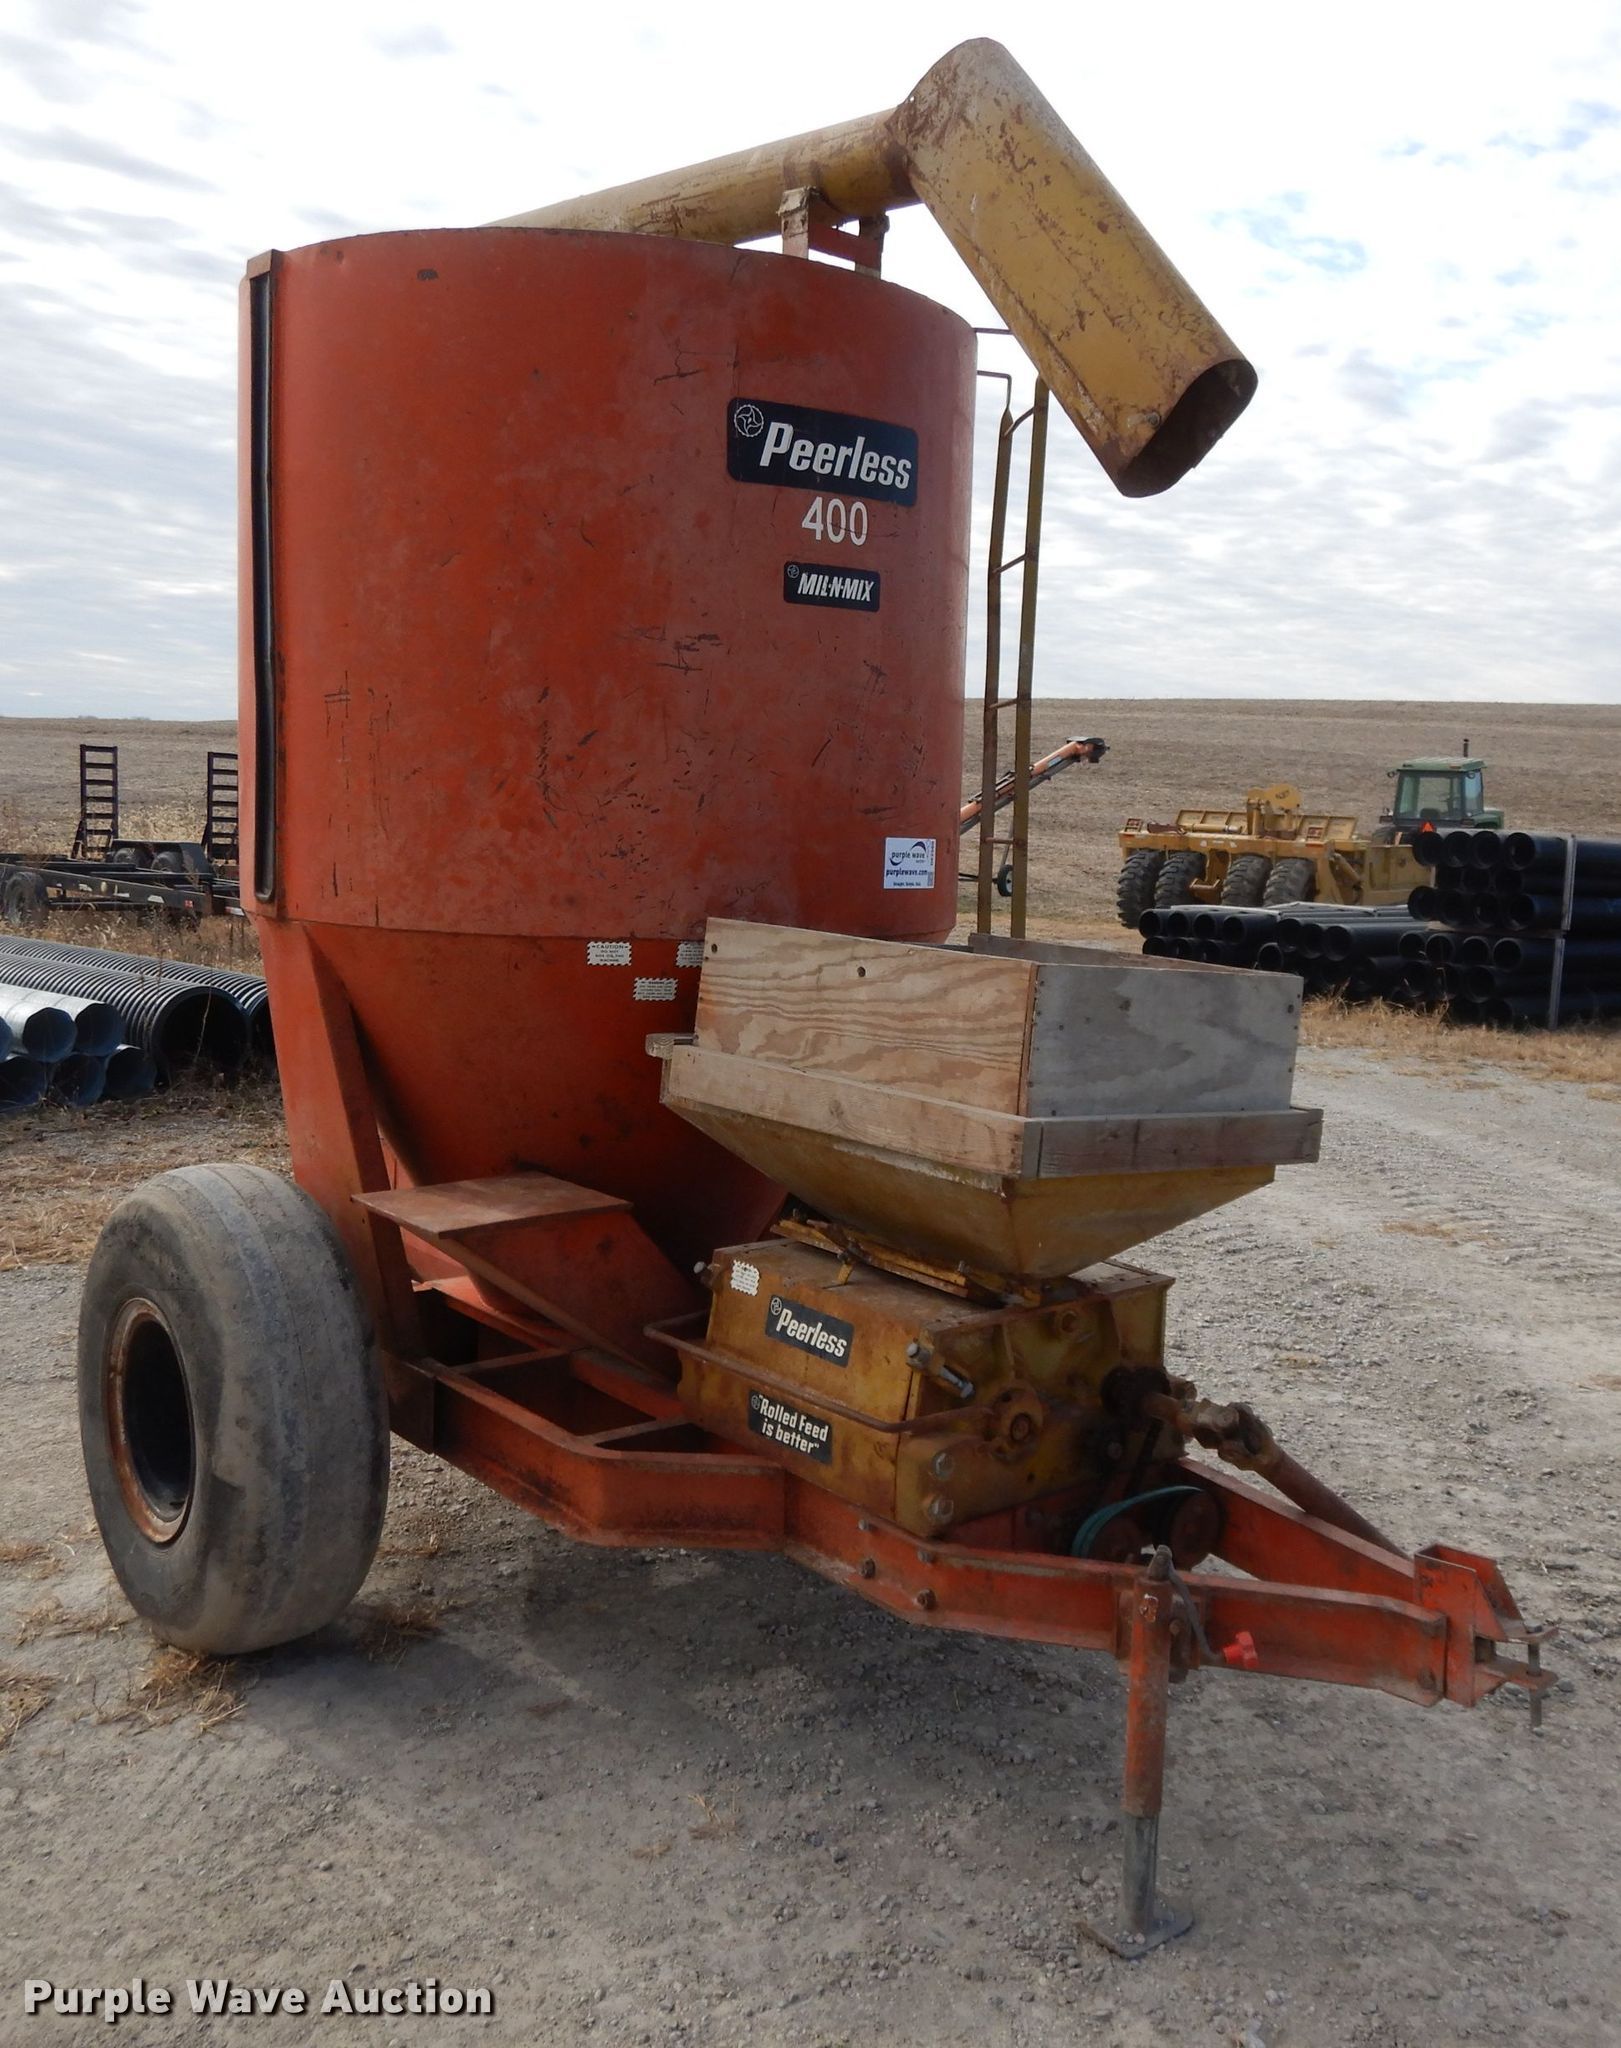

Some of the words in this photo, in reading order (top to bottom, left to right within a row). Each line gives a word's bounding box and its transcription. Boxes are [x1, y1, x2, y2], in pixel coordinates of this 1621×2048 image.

[759, 421, 912, 489] Peerless
[801, 496, 868, 546] 400
[891, 851, 910, 860] purple
[776, 1308, 847, 1358] Peerless
[762, 1418, 774, 1437] is
[799, 1415, 829, 1442] Feed
